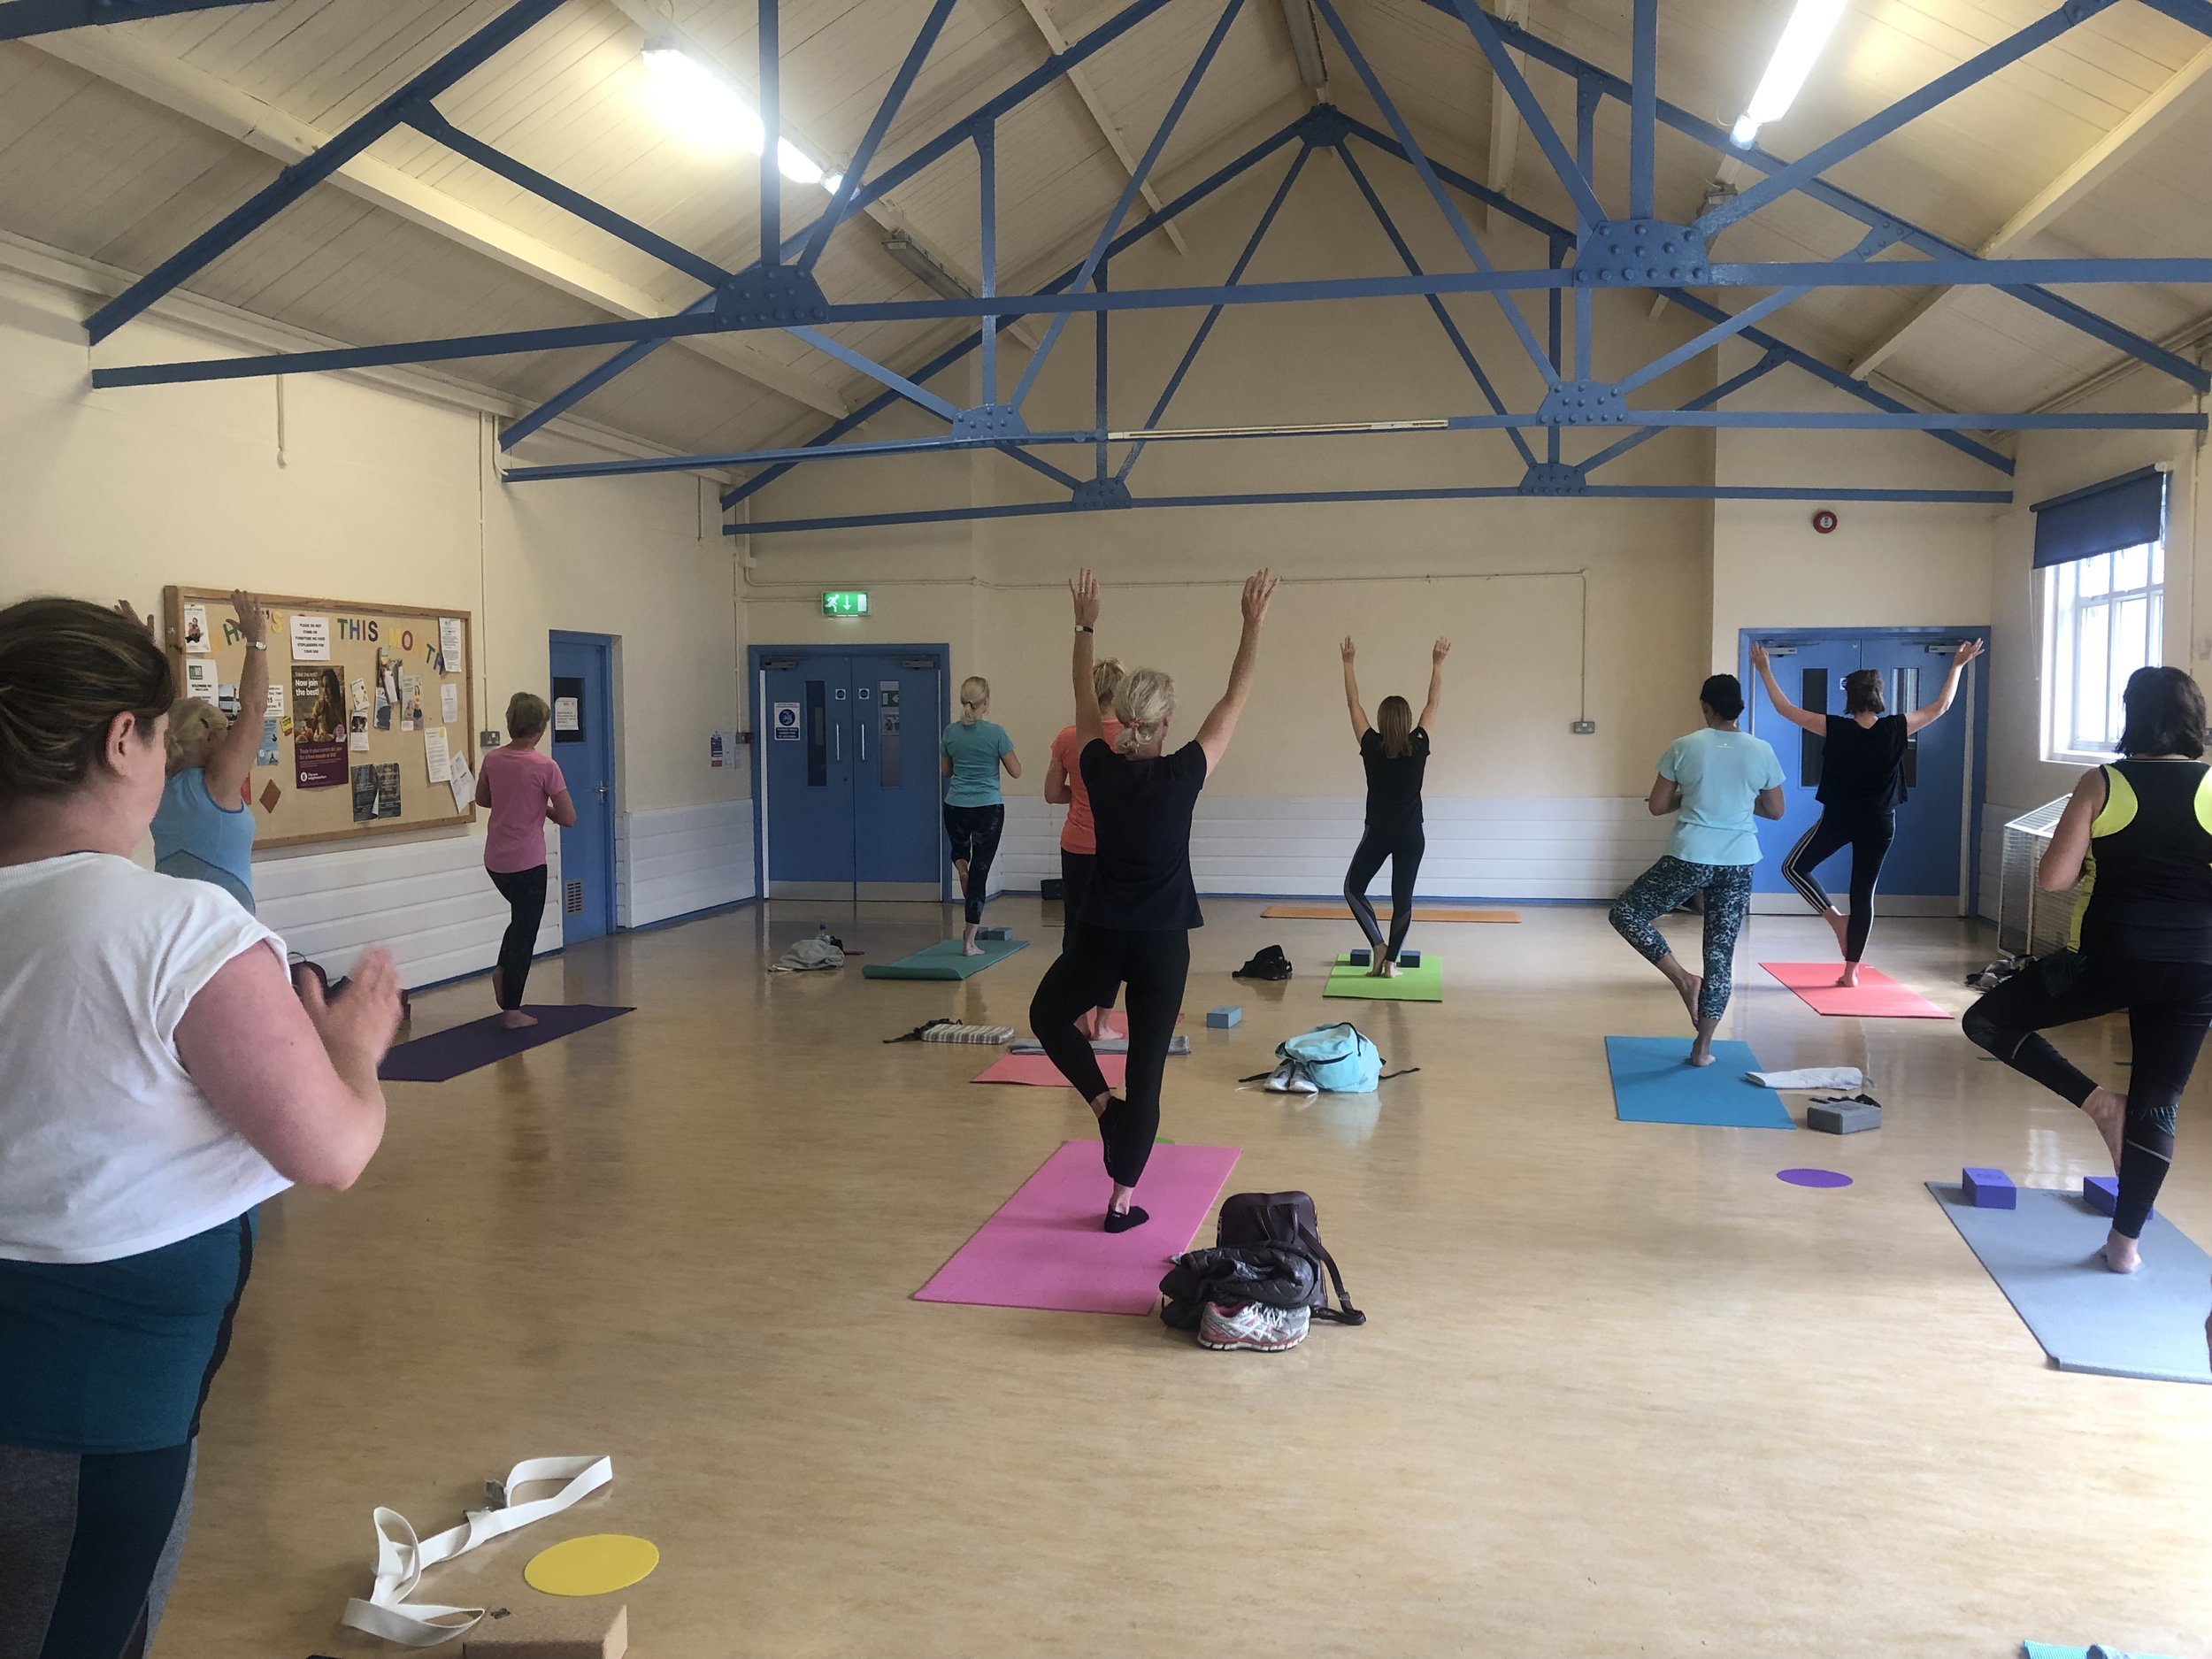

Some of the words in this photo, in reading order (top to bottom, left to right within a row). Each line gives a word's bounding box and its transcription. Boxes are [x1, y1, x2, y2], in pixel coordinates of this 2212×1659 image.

[337, 618, 378, 641] THIS
[308, 678, 318, 688] join
[296, 687, 306, 696] the
[306, 687, 319, 696] best!
